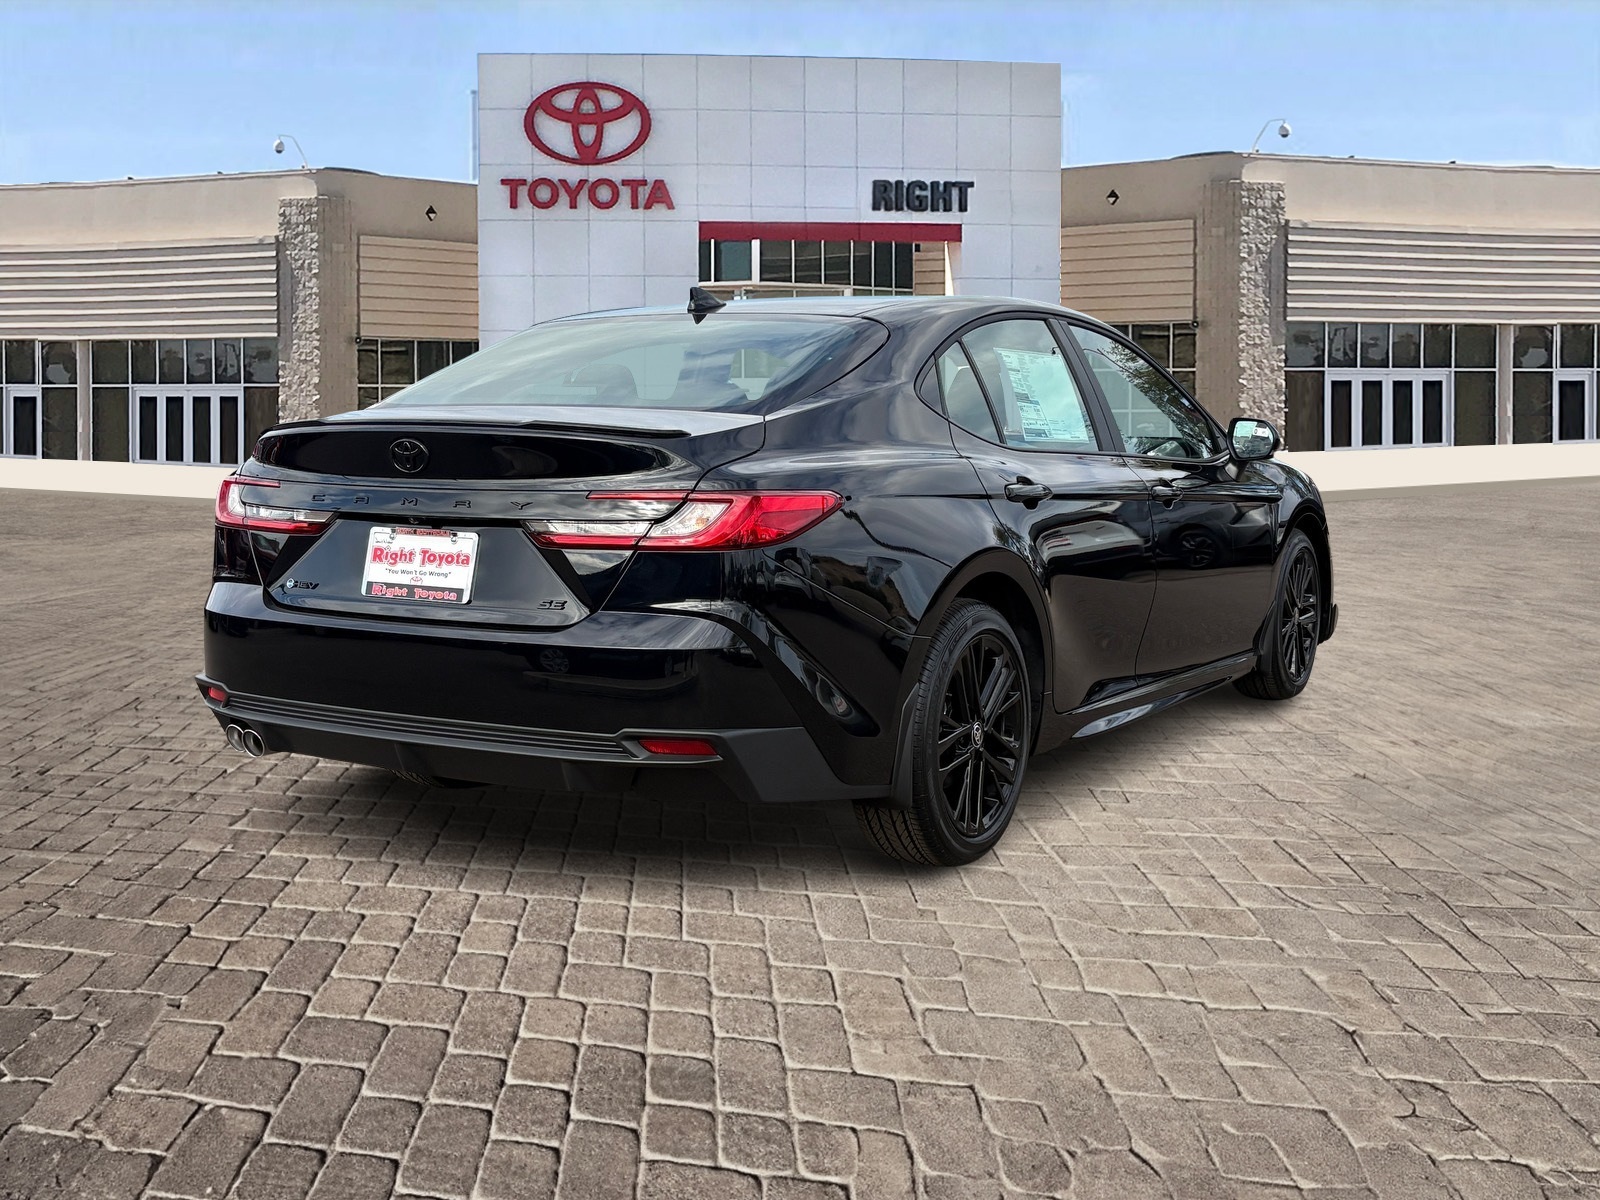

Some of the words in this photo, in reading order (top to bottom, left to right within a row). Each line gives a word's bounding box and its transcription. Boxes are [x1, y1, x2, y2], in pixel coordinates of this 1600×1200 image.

[500, 177, 675, 210] TOYOTA
[872, 179, 975, 212] RIGHT
[311, 494, 533, 511] CAMRY
[371, 546, 416, 567] Right
[420, 549, 470, 567] Toyota
[372, 583, 408, 597] Right
[414, 588, 457, 600] Toyota
[537, 600, 568, 611] SE
